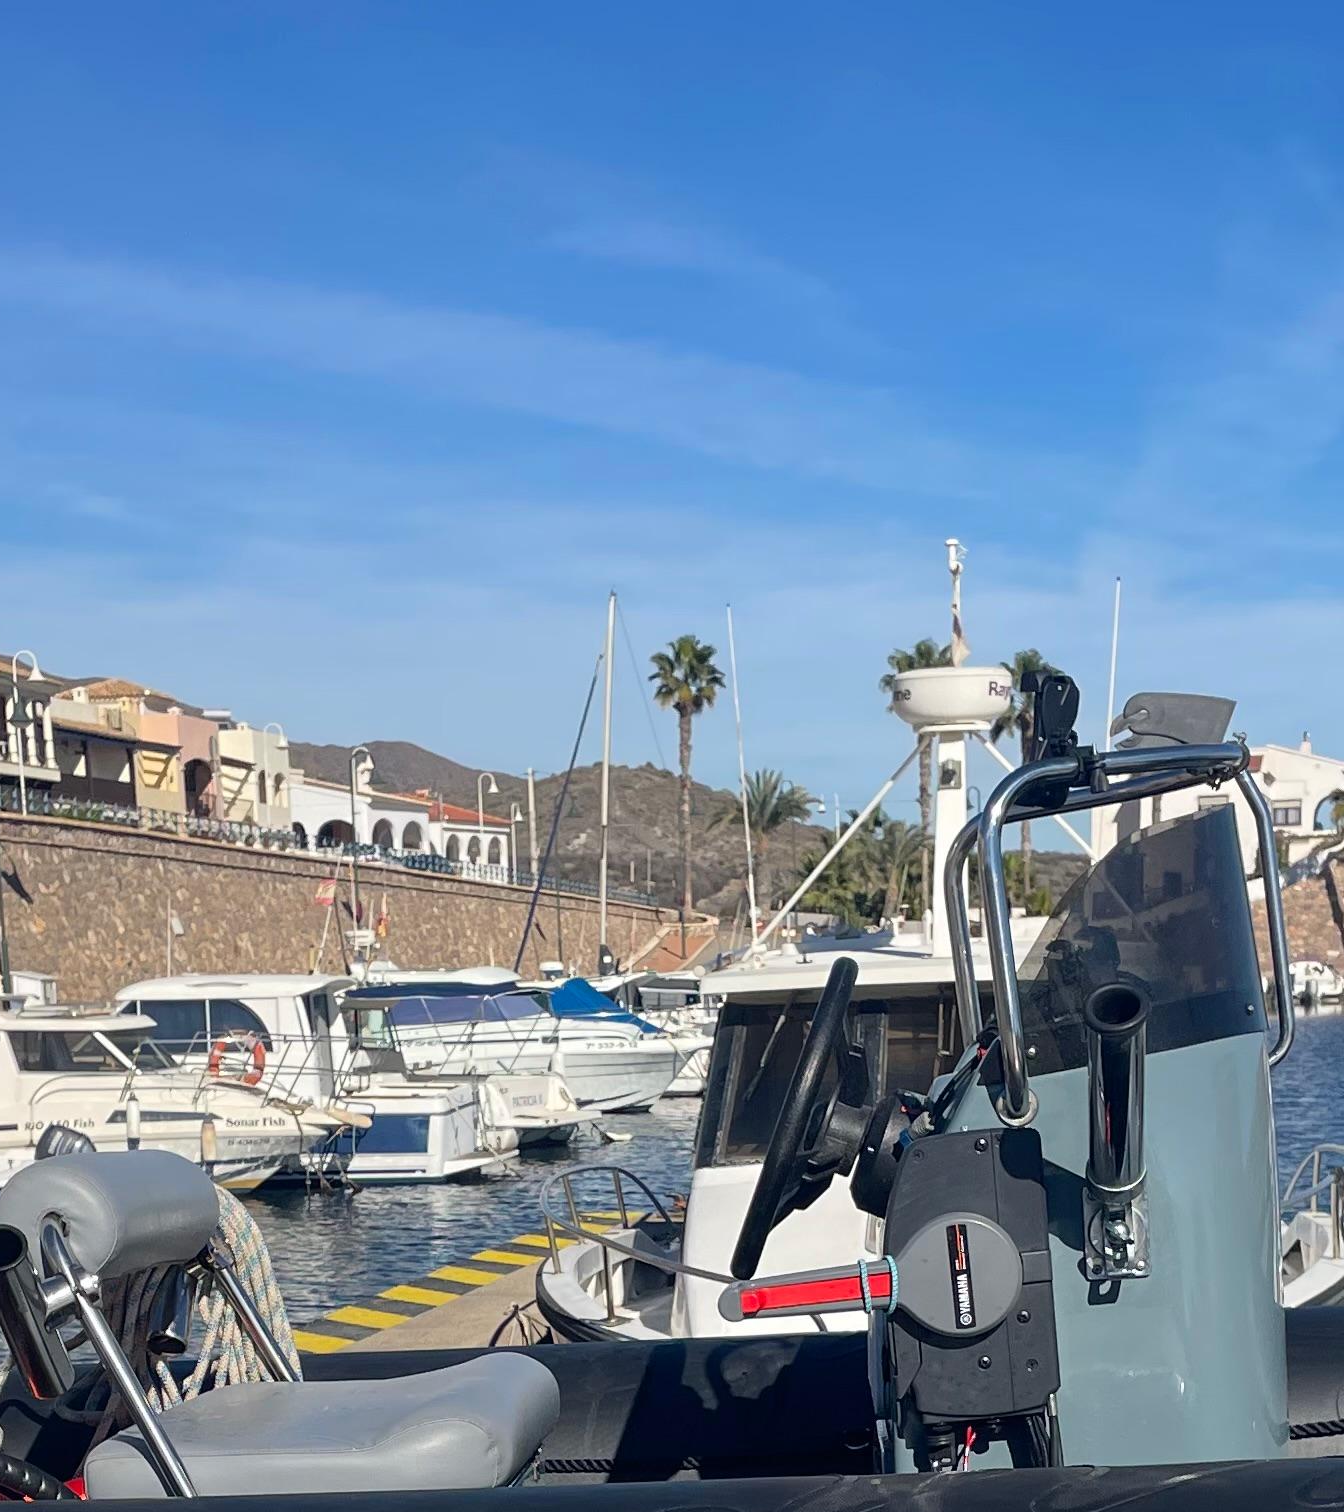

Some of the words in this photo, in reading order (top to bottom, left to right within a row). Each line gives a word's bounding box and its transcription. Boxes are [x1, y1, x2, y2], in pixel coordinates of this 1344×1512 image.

[25, 1121, 44, 1130] RIO
[74, 1117, 95, 1128] Fish
[226, 1118, 260, 1128] Sonar
[262, 1116, 286, 1127] Fish
[957, 1273, 971, 1314] YAMAHA
